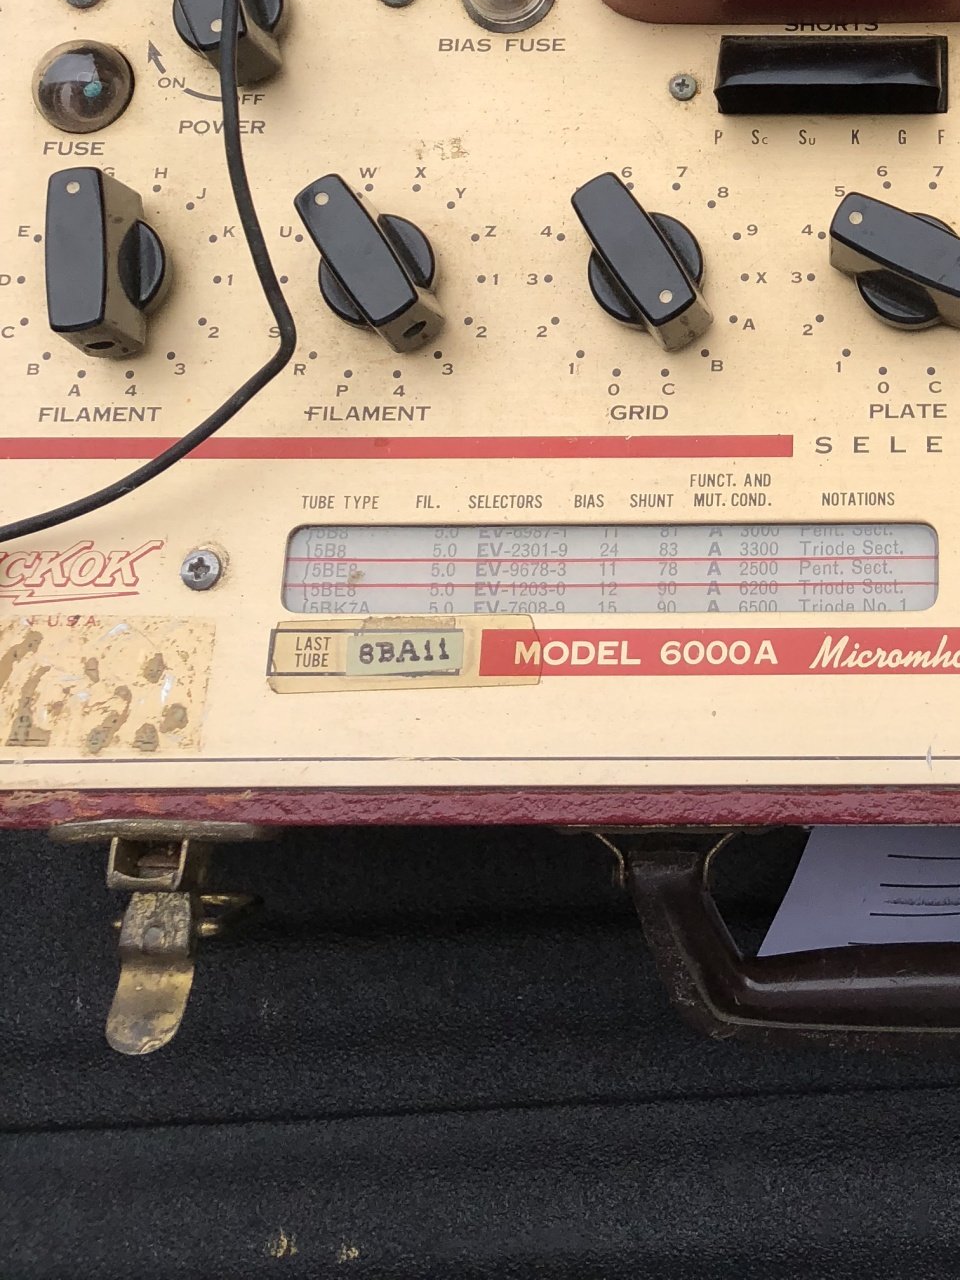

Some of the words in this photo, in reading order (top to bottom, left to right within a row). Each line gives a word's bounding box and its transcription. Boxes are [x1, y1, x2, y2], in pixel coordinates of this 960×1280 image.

[438, 39, 492, 52] BIAS
[505, 38, 566, 52] FUSE
[158, 77, 186, 89] ON
[43, 142, 104, 156] FUSE
[38, 407, 162, 422] FILAMENT
[307, 406, 431, 422] FILAMENT
[610, 404, 669, 421] GRID
[869, 403, 948, 420] PLATE
[690, 472, 737, 487] FUNCT.
[744, 472, 772, 486] AND
[302, 495, 336, 510] TUBE
[344, 495, 380, 510] TYPE
[416, 494, 441, 509] FIL.
[468, 494, 543, 509] SELECTORS
[574, 494, 605, 508] BIAS
[630, 494, 674, 508] SHUNT
[694, 493, 726, 508] MUT.
[731, 493, 772, 508] COND.
[821, 492, 896, 506] NOTATIONS
[314, 544, 346, 558] 5B8
[432, 544, 458, 558] 5.0
[476, 543, 568, 558] EV-2301-9
[600, 544, 620, 558] 24
[658, 542, 678, 556] 83
[708, 544, 722, 557] A
[740, 542, 779, 556] 3300
[802, 541, 855, 556] Triode
[862, 541, 904, 556] Sect.
[431, 563, 456, 577] 5.0
[475, 562, 567, 577] EV-9678-3
[658, 562, 678, 576] 78
[707, 562, 722, 576] A
[739, 562, 778, 576] 2500
[800, 561, 844, 576] Pent.
[852, 560, 893, 574] Sect.
[295, 637, 332, 652] LAST
[359, 637, 450, 665] 8BA11
[295, 653, 329, 668] TUBE
[514, 640, 641, 666] MODEL
[660, 640, 778, 666] 6000A
